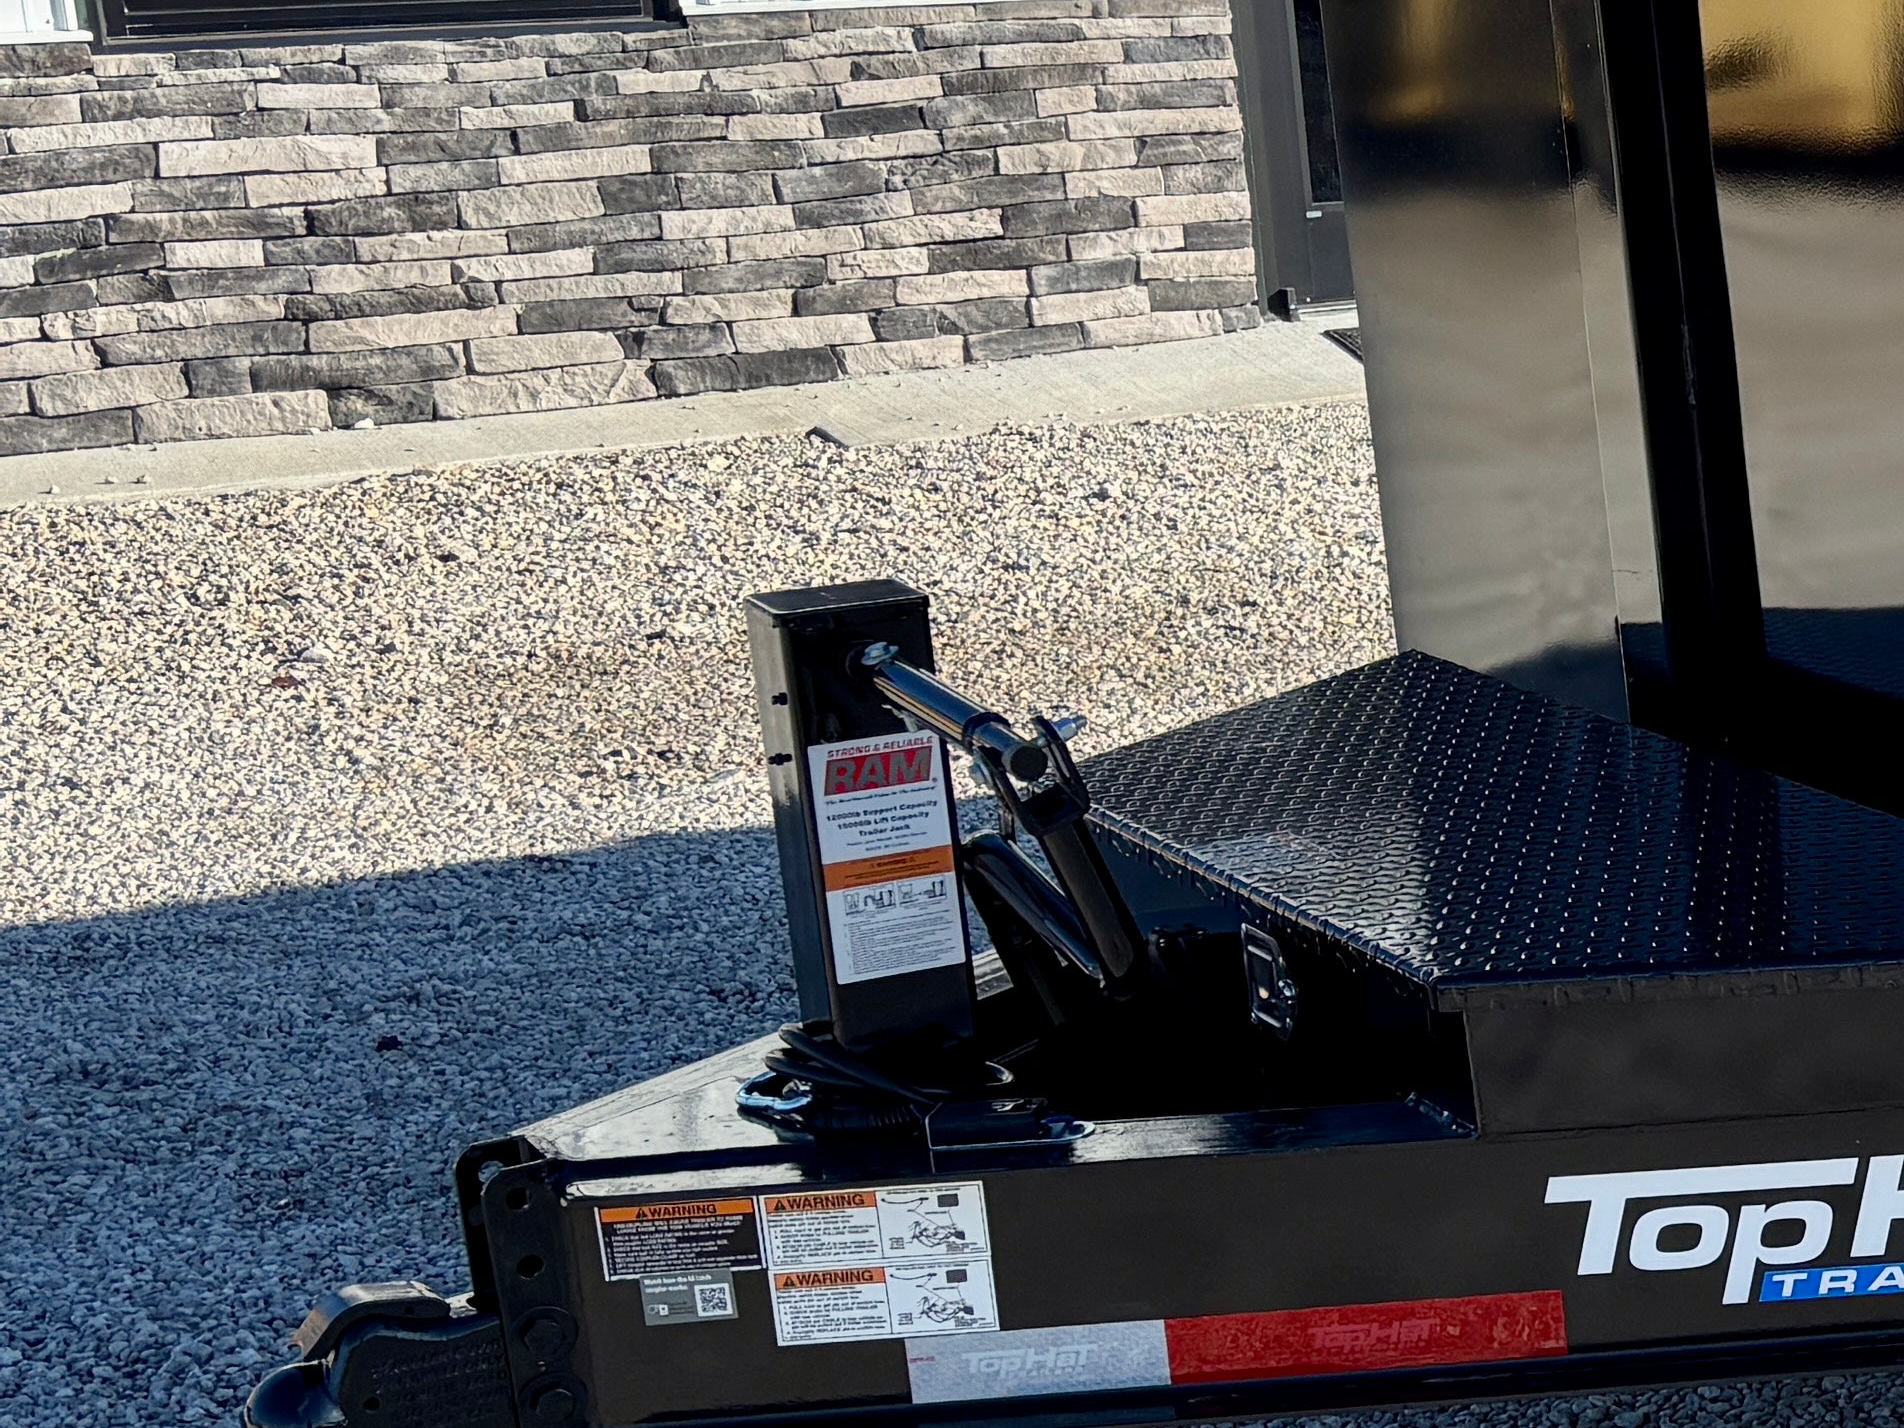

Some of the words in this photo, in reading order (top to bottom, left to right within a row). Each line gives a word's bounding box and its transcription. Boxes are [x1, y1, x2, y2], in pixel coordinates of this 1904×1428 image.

[826, 746, 932, 794] RAM
[650, 1202, 718, 1219] WARNING
[787, 1193, 866, 1211] WARNING
[796, 1269, 874, 1287] WARNING
